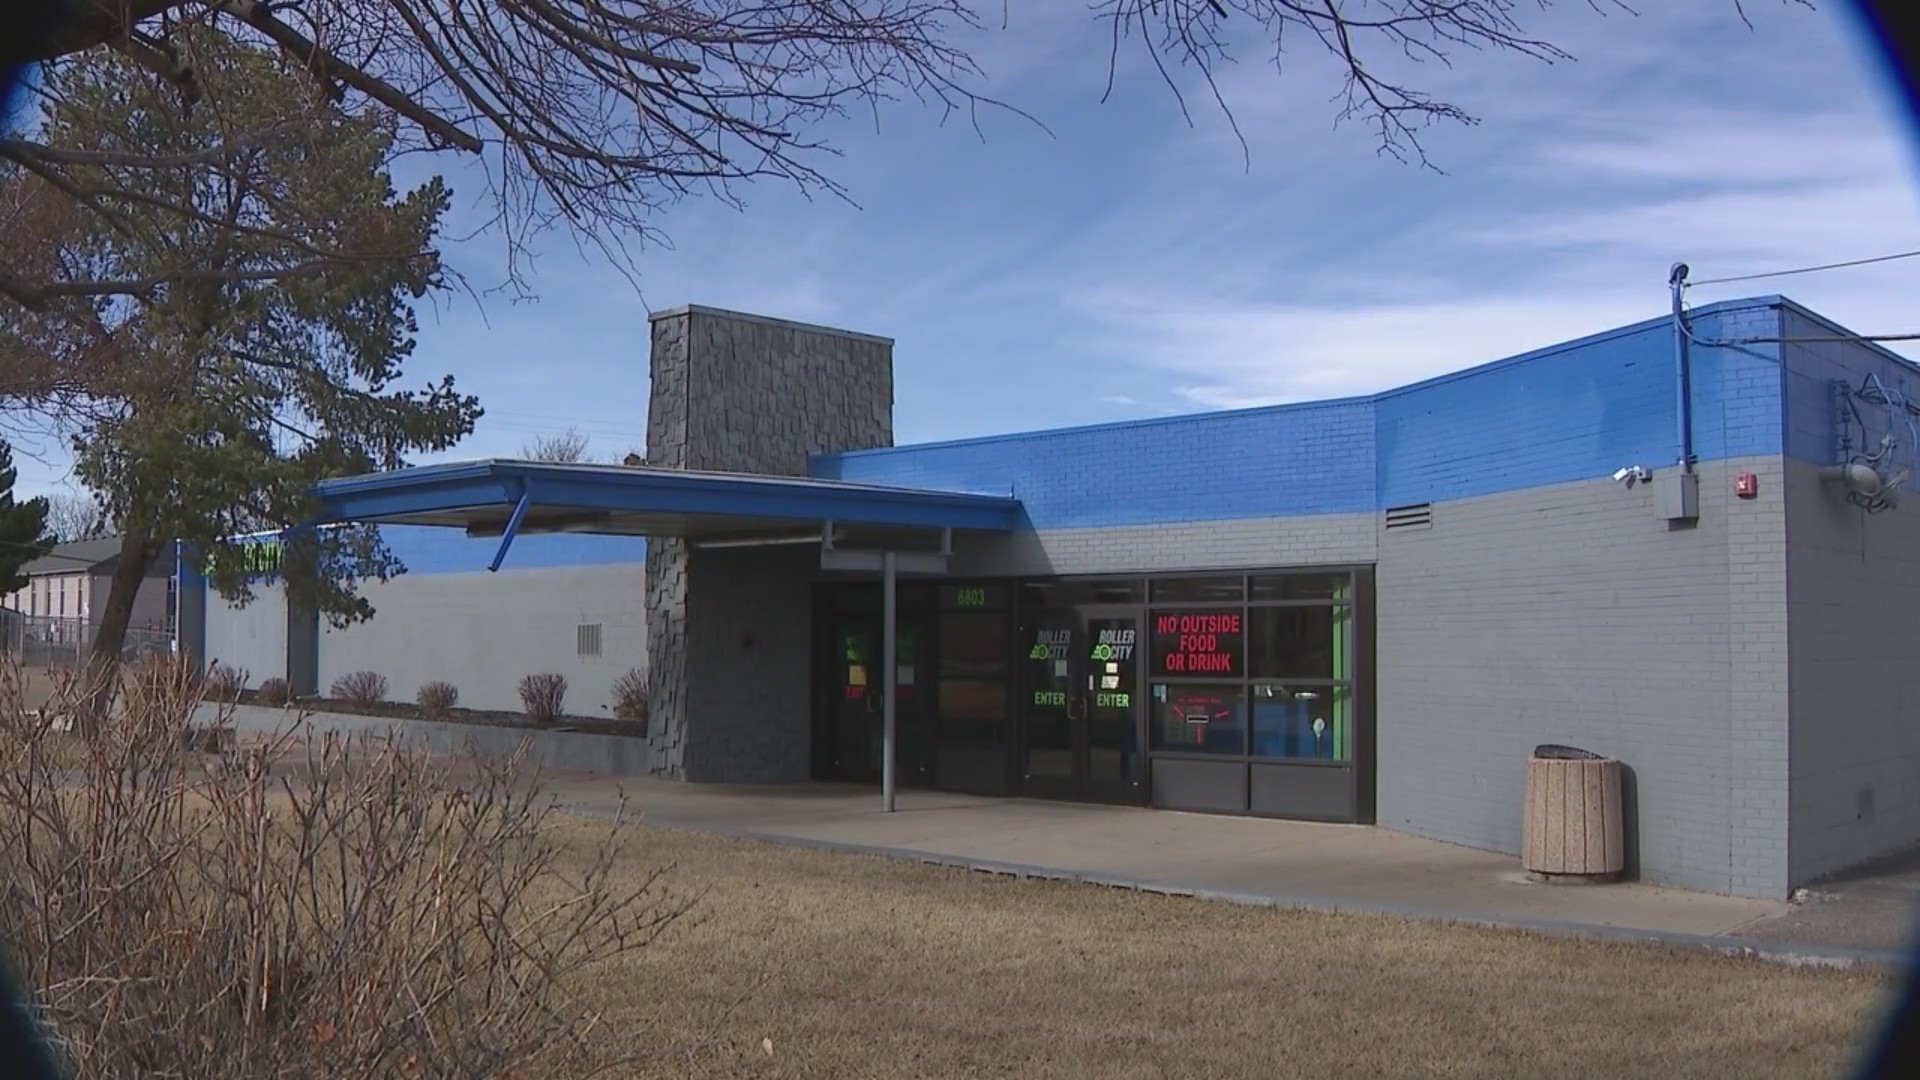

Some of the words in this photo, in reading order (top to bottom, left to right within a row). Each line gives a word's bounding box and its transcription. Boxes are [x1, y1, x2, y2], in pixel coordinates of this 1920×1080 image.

[1158, 616, 1178, 633] NO
[1180, 615, 1240, 633] OUTSIDE
[1038, 630, 1071, 645] ROLLER
[1099, 630, 1135, 645] ROLLER
[1180, 635, 1216, 652] FOOD
[1110, 645, 1133, 660] CITY
[1166, 654, 1185, 670] OR
[1188, 654, 1231, 671] DRINK
[1034, 692, 1066, 705] ENTER
[1097, 693, 1129, 707] ENTER
